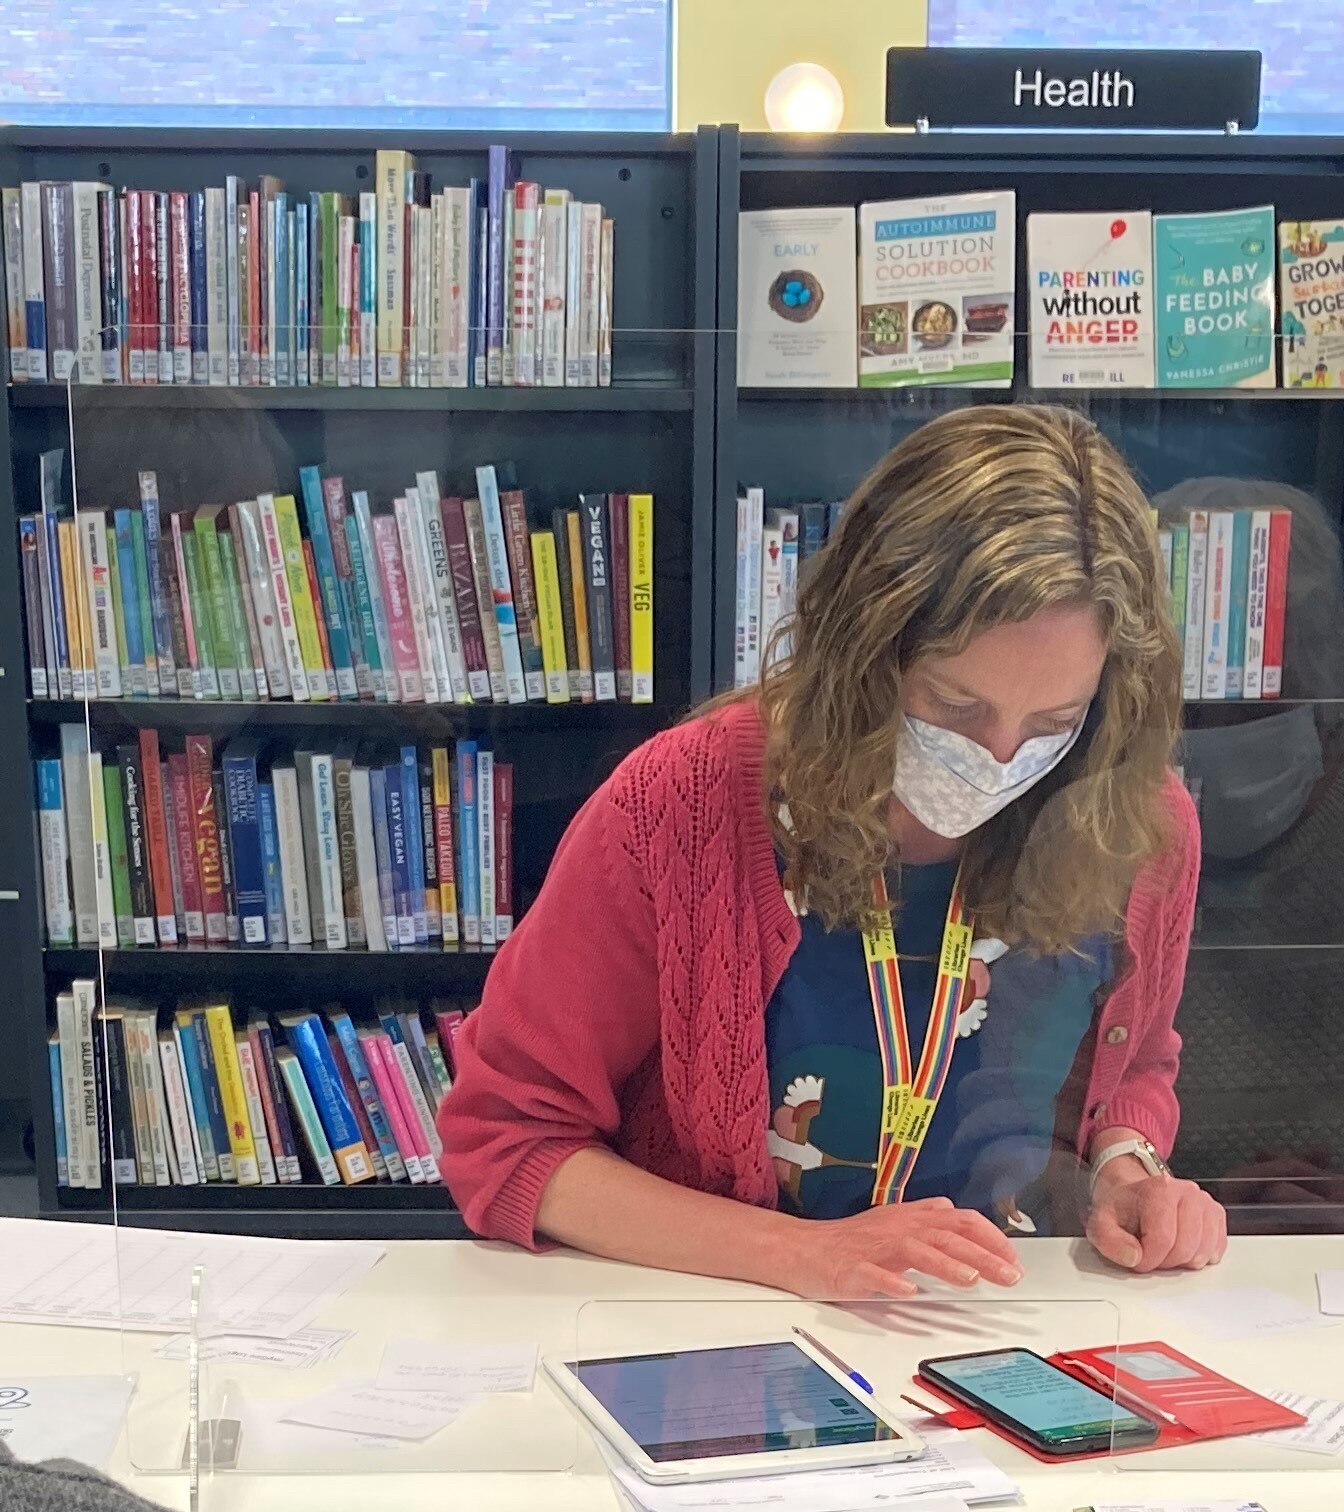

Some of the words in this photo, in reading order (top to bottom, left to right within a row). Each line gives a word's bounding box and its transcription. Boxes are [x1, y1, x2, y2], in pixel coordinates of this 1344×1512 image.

[1014, 69, 1134, 107] Health
[387, 168, 396, 193] More
[924, 205, 946, 213] THE
[80, 209, 92, 260] Postnatal
[387, 224, 396, 254] Words
[877, 214, 995, 238] AUTOIMMUNE
[774, 243, 818, 257] EARLY
[876, 236, 994, 261] SOLUTION
[876, 256, 994, 281] COOKBOOK
[1039, 270, 1145, 288] PARENTING
[1171, 275, 1199, 287] The
[1202, 262, 1259, 287] BABY
[82, 263, 94, 321] Depression
[1043, 288, 1141, 317] without
[1166, 285, 1272, 313] FEEDING
[1046, 321, 1139, 344] ANGER
[1184, 312, 1248, 336] BOOK
[891, 358, 915, 367] AMY
[962, 352, 979, 361] MD
[1166, 365, 1216, 380] VANESSA
[509, 503, 523, 531] Little
[428, 519, 448, 578] GREENS
[490, 533, 500, 565] Detox
[514, 534, 527, 566] Green
[350, 540, 370, 605] KETOGENIC
[362, 610, 374, 637] DIET
[382, 541, 404, 617] Wholesome
[518, 568, 532, 608] Kitchen
[634, 583, 650, 611] VEG
[97, 609, 108, 649] HANDBOOK
[318, 764, 327, 779] Get
[481, 757, 489, 776] FAST
[126, 766, 136, 805] Cooking
[228, 769, 238, 823] COOKBOOK
[236, 769, 247, 822] DIABETIC
[245, 769, 255, 822] COMPLETE
[336, 772, 351, 798] Oh
[128, 807, 138, 820] for
[175, 782, 188, 826] MIDLIFE
[339, 800, 353, 828] She
[391, 792, 402, 821] EASY
[130, 821, 139, 836] the
[320, 811, 331, 835] Stay
[437, 807, 452, 837] PALEO
[132, 837, 142, 867] Senses
[181, 832, 195, 883] KITCHEN
[324, 837, 332, 860] Lean
[340, 831, 355, 882] Glows
[394, 825, 404, 864] VEGAN
[426, 848, 436, 880] RECIPES
[440, 840, 454, 882] TAKEOUT
[952, 943, 960, 971] Libraries
[957, 949, 965, 972] Change
[961, 931, 969, 948] Lives
[217, 1018, 225, 1030] The
[219, 1032, 231, 1054] Orchid
[81, 1041, 93, 1077] SALADS
[396, 1047, 418, 1096] PARENTING
[70, 1109, 78, 1135] made
[84, 1089, 96, 1126] PICKLES
[906, 1115, 920, 1141] Libraries
[913, 1121, 924, 1143] Change
[920, 1105, 931, 1120] Lives
